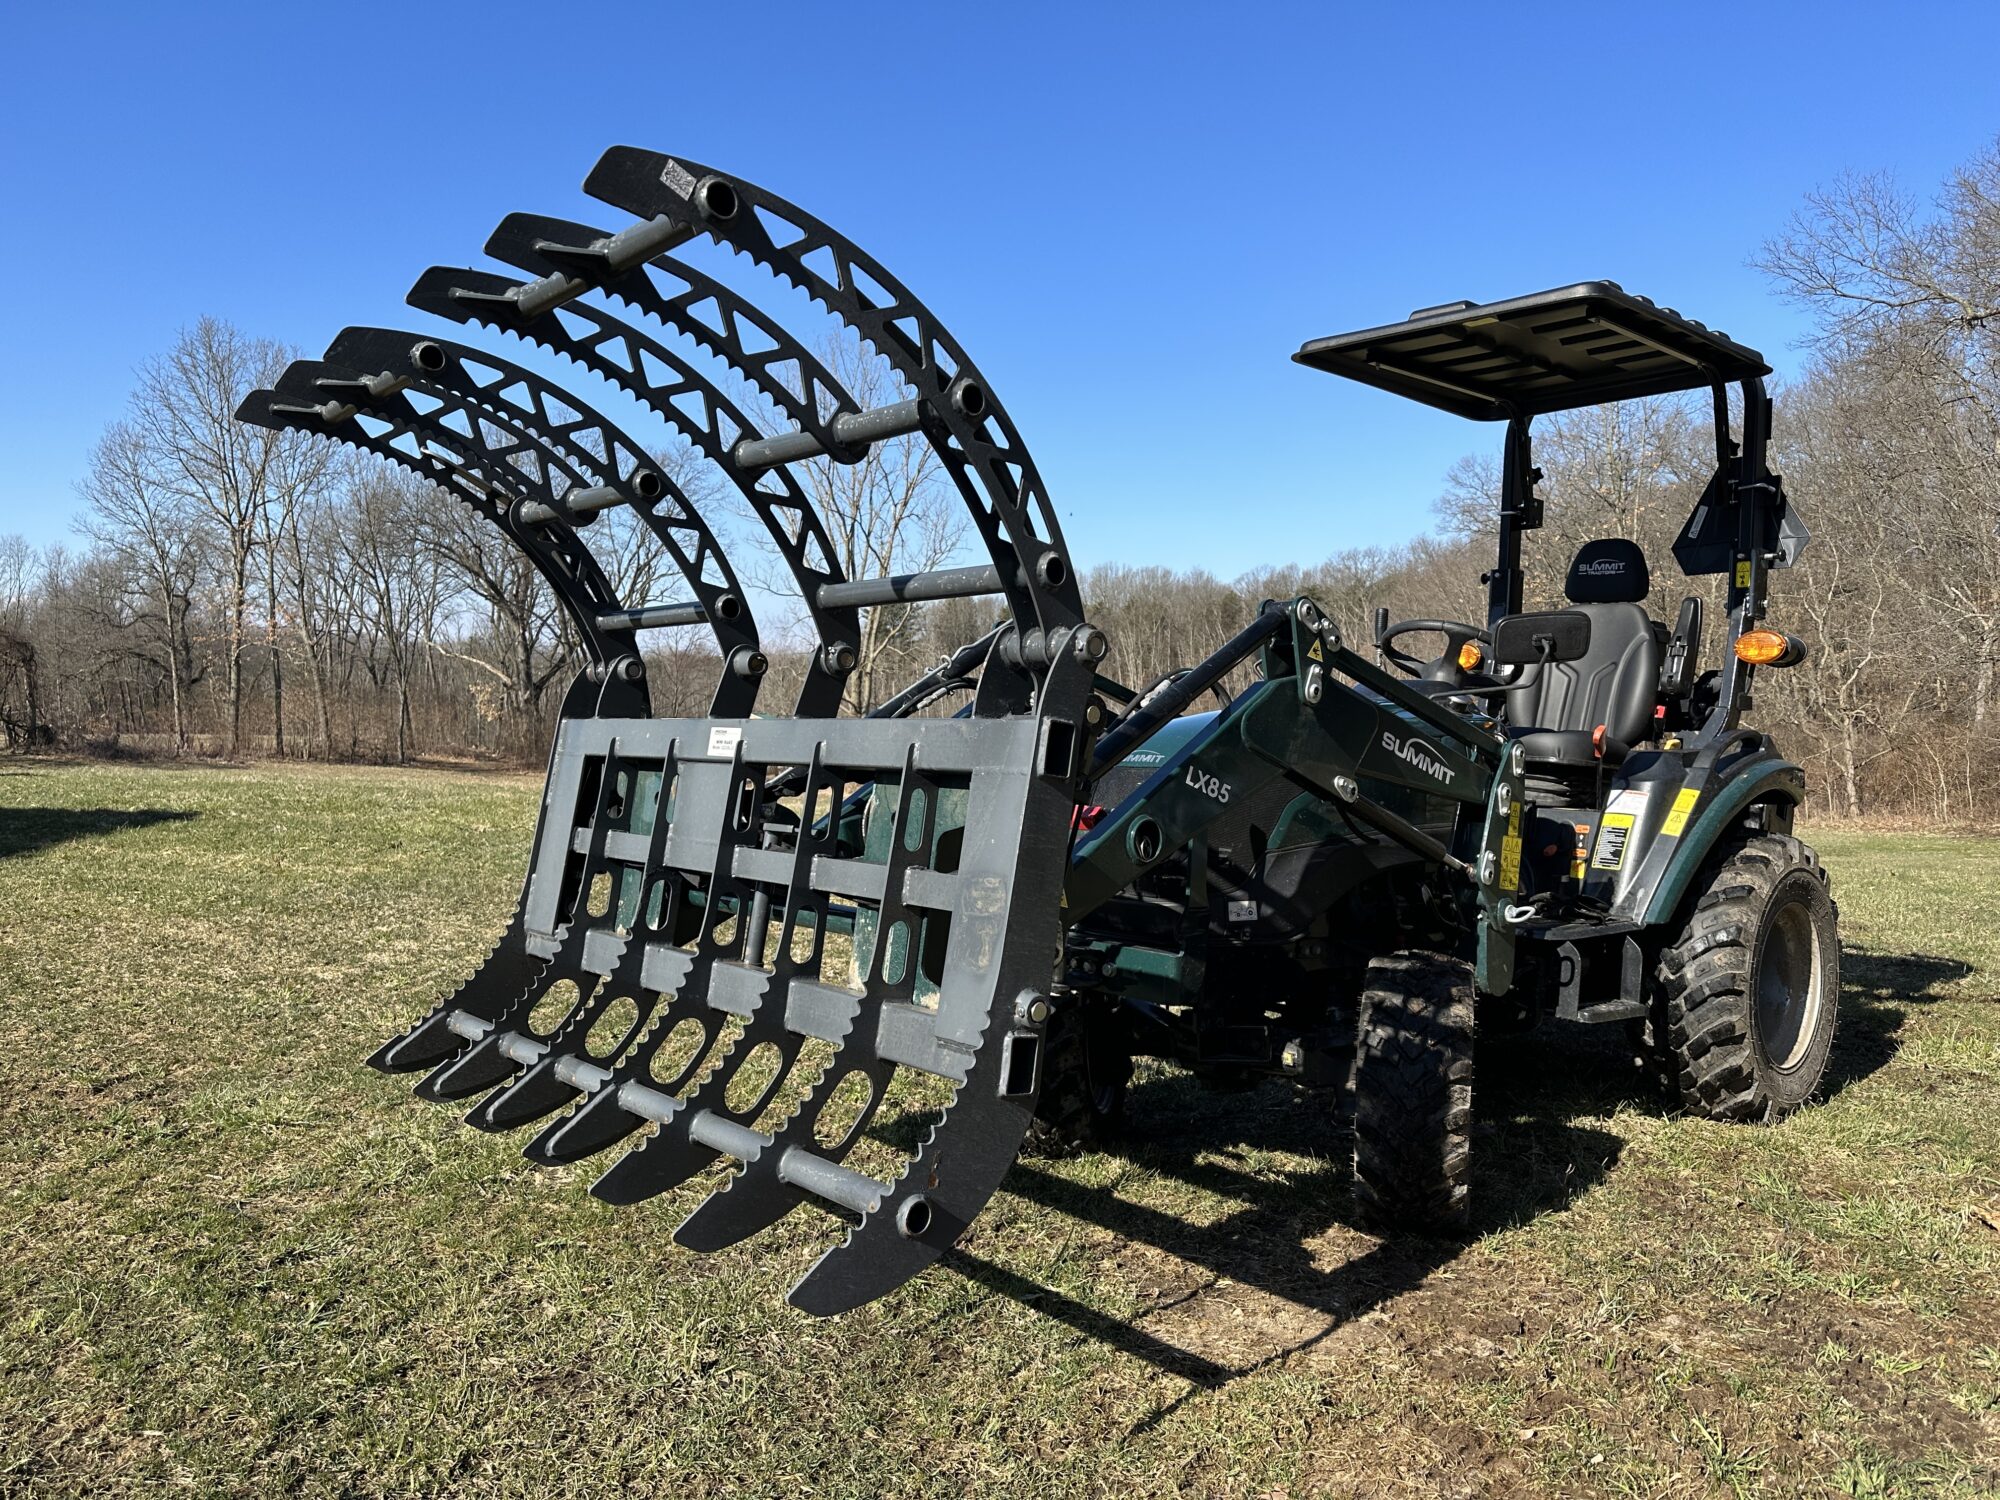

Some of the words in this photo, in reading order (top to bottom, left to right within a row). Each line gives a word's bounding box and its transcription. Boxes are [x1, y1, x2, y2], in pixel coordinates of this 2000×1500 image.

[1579, 559, 1625, 571] SUMMIT
[1382, 731, 1455, 784] SUMMIT
[1185, 765, 1231, 803] LX85
